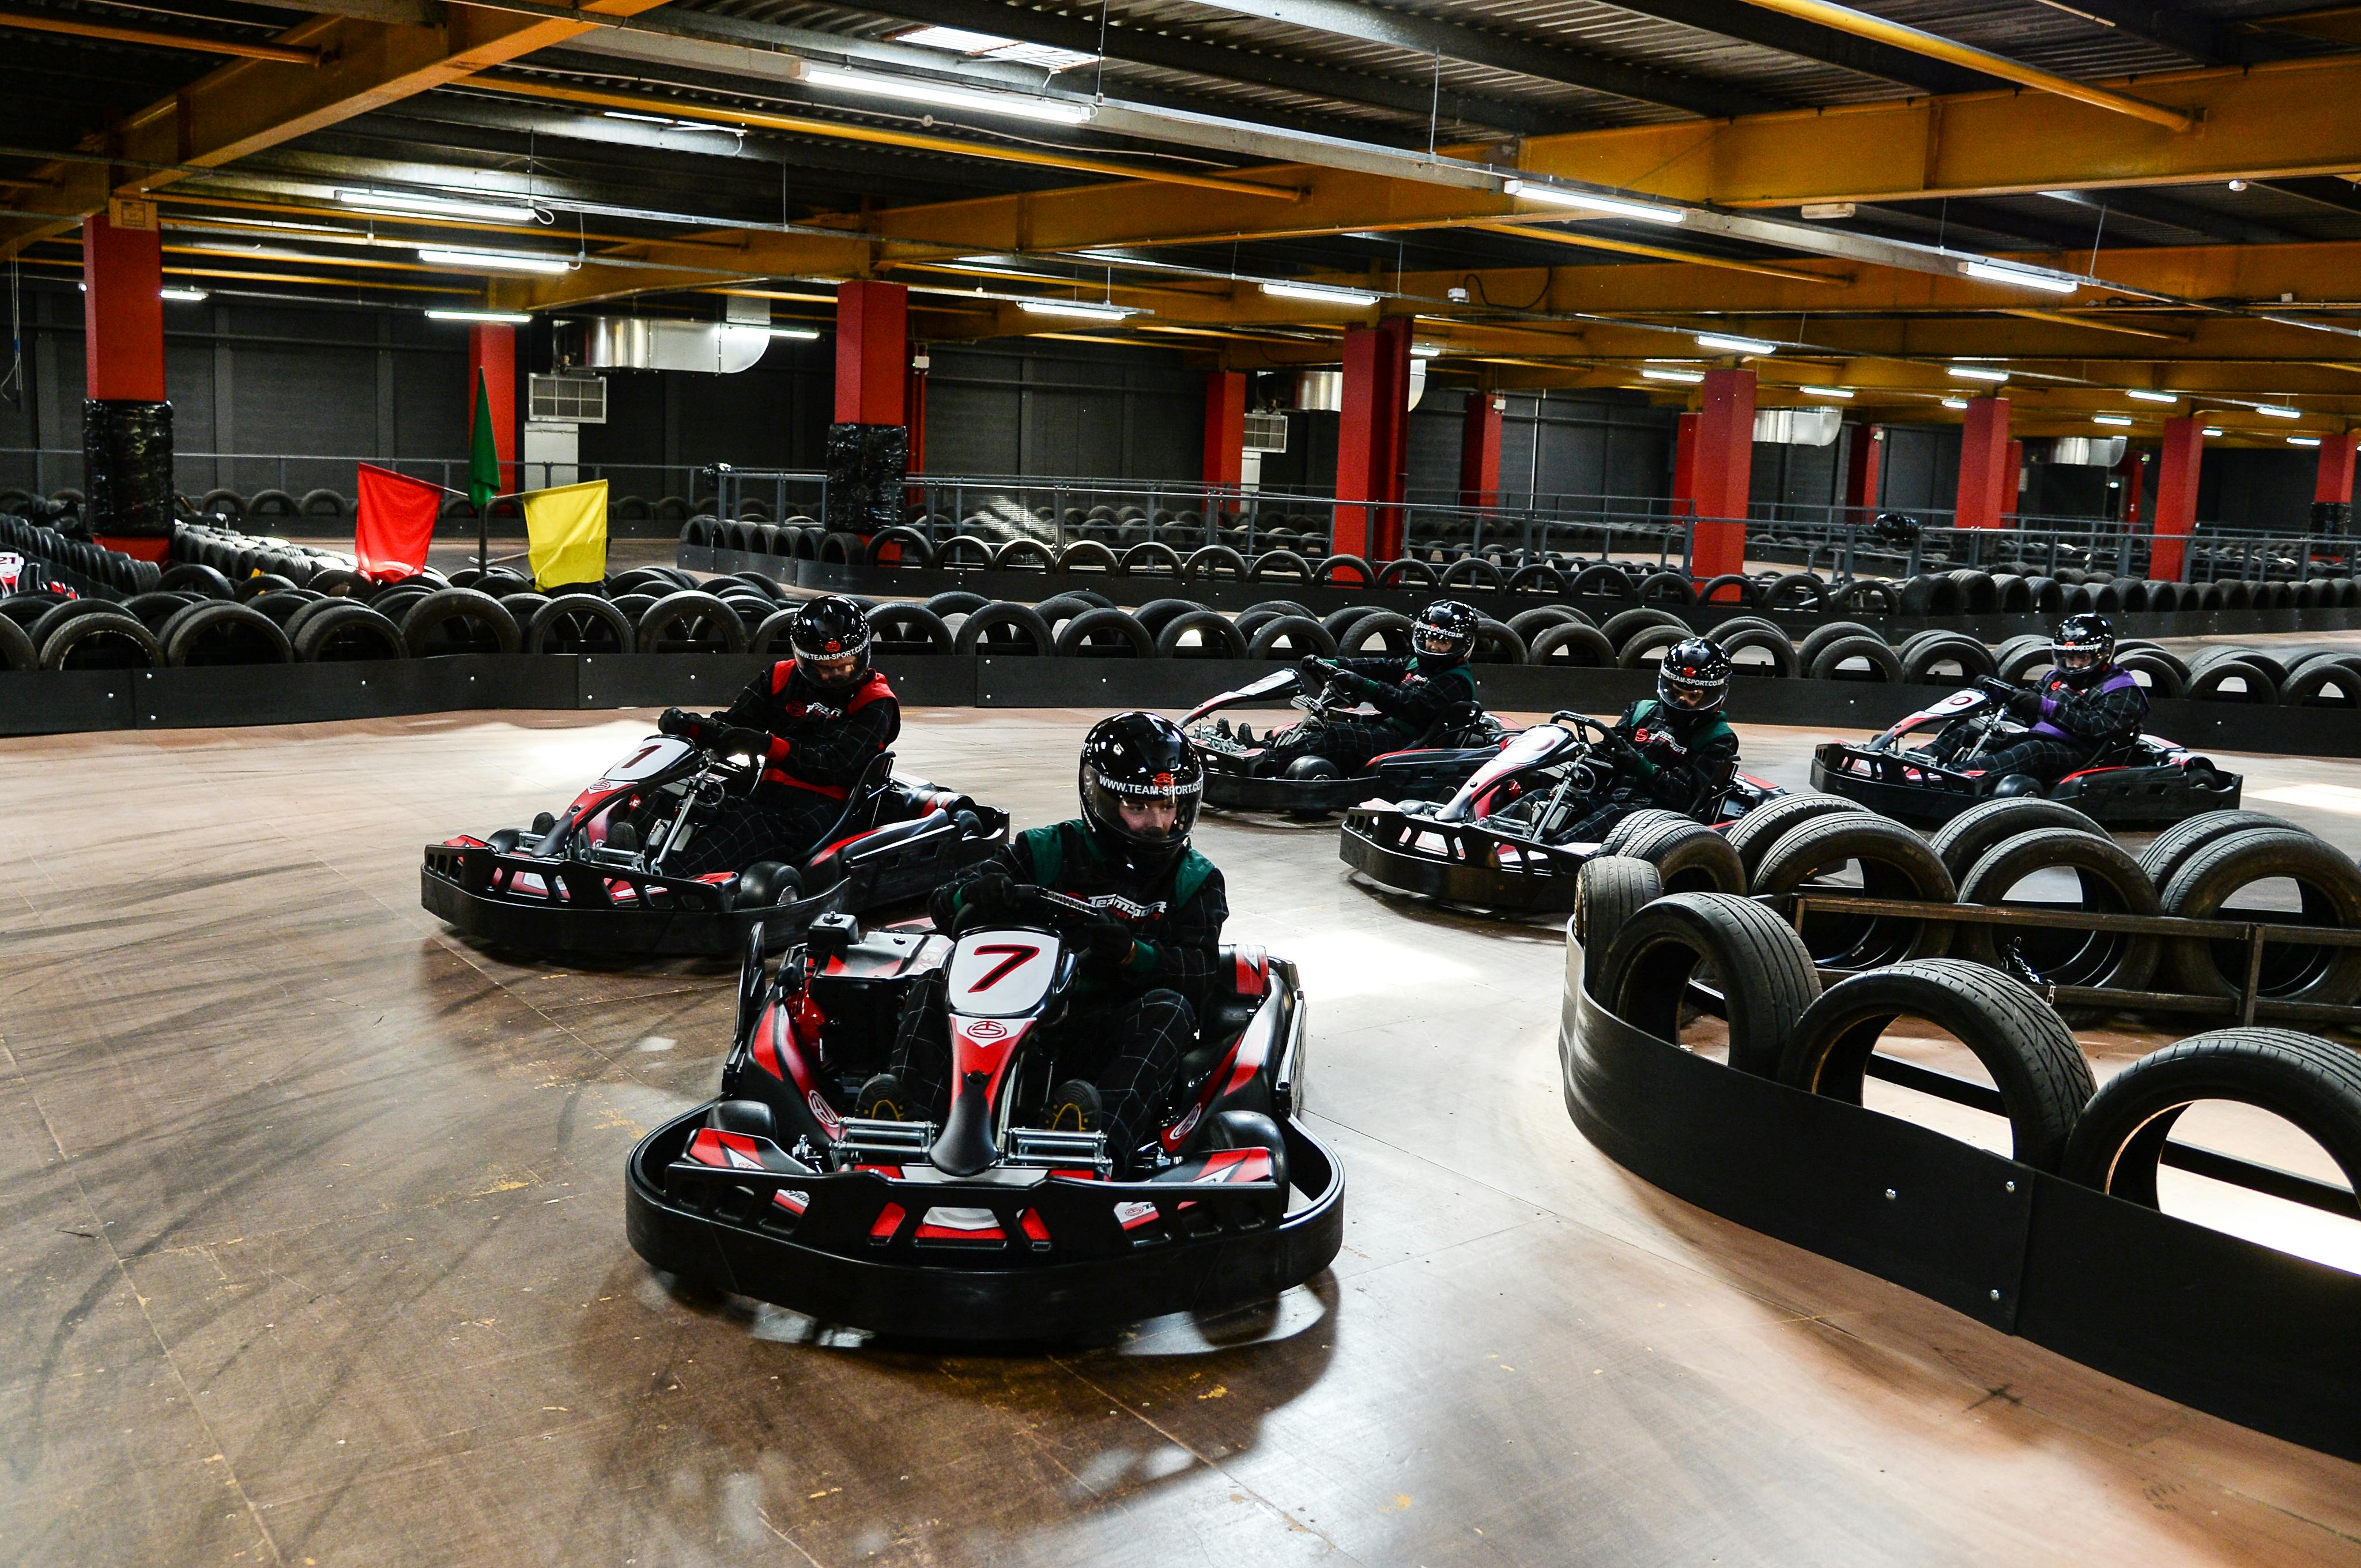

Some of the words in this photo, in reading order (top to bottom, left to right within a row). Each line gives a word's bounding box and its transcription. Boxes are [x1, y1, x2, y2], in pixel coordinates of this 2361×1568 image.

[621, 745, 662, 769] 1
[1099, 774, 1202, 796] WWW.TEAM-SPORT.CO
[967, 944, 1041, 993] 7
